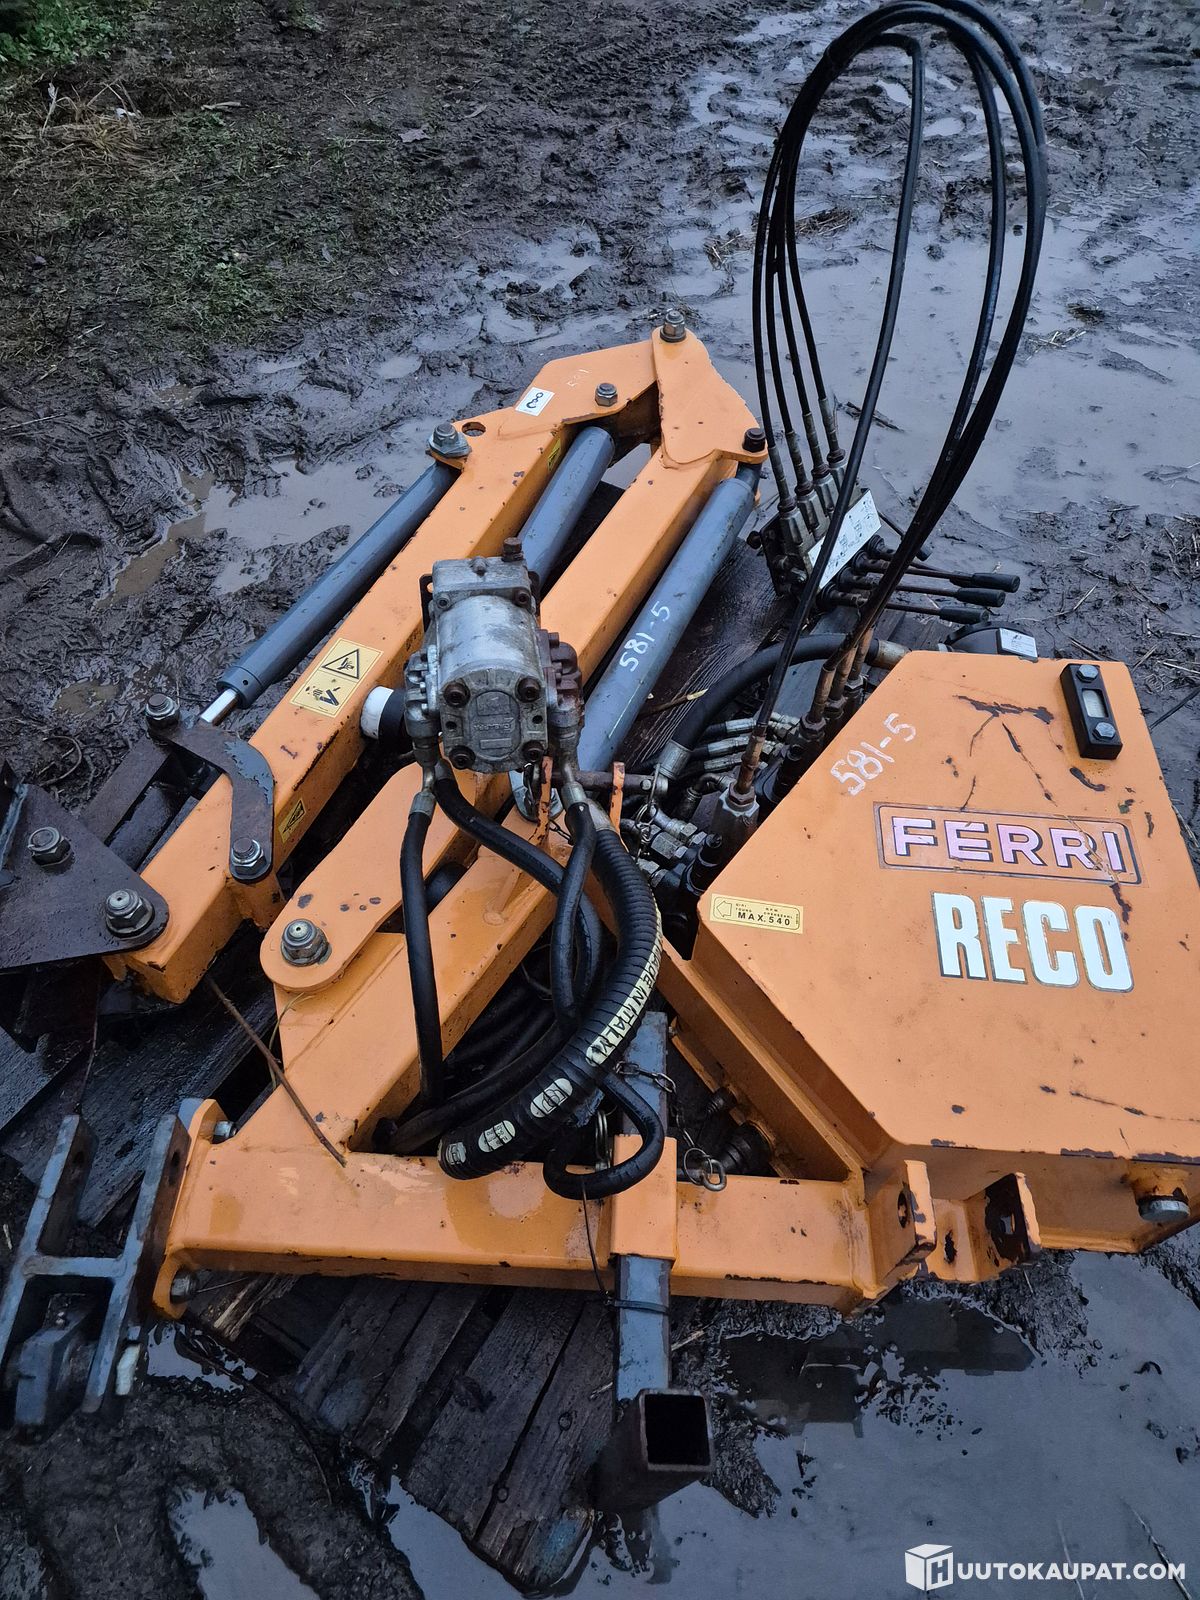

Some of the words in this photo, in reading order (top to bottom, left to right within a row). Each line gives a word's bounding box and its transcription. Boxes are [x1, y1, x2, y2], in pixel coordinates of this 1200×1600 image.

[619, 601, 670, 672] 581-5
[830, 712, 916, 796] 581-5
[892, 816, 1127, 873] FERRI
[931, 890, 1135, 993] RECO
